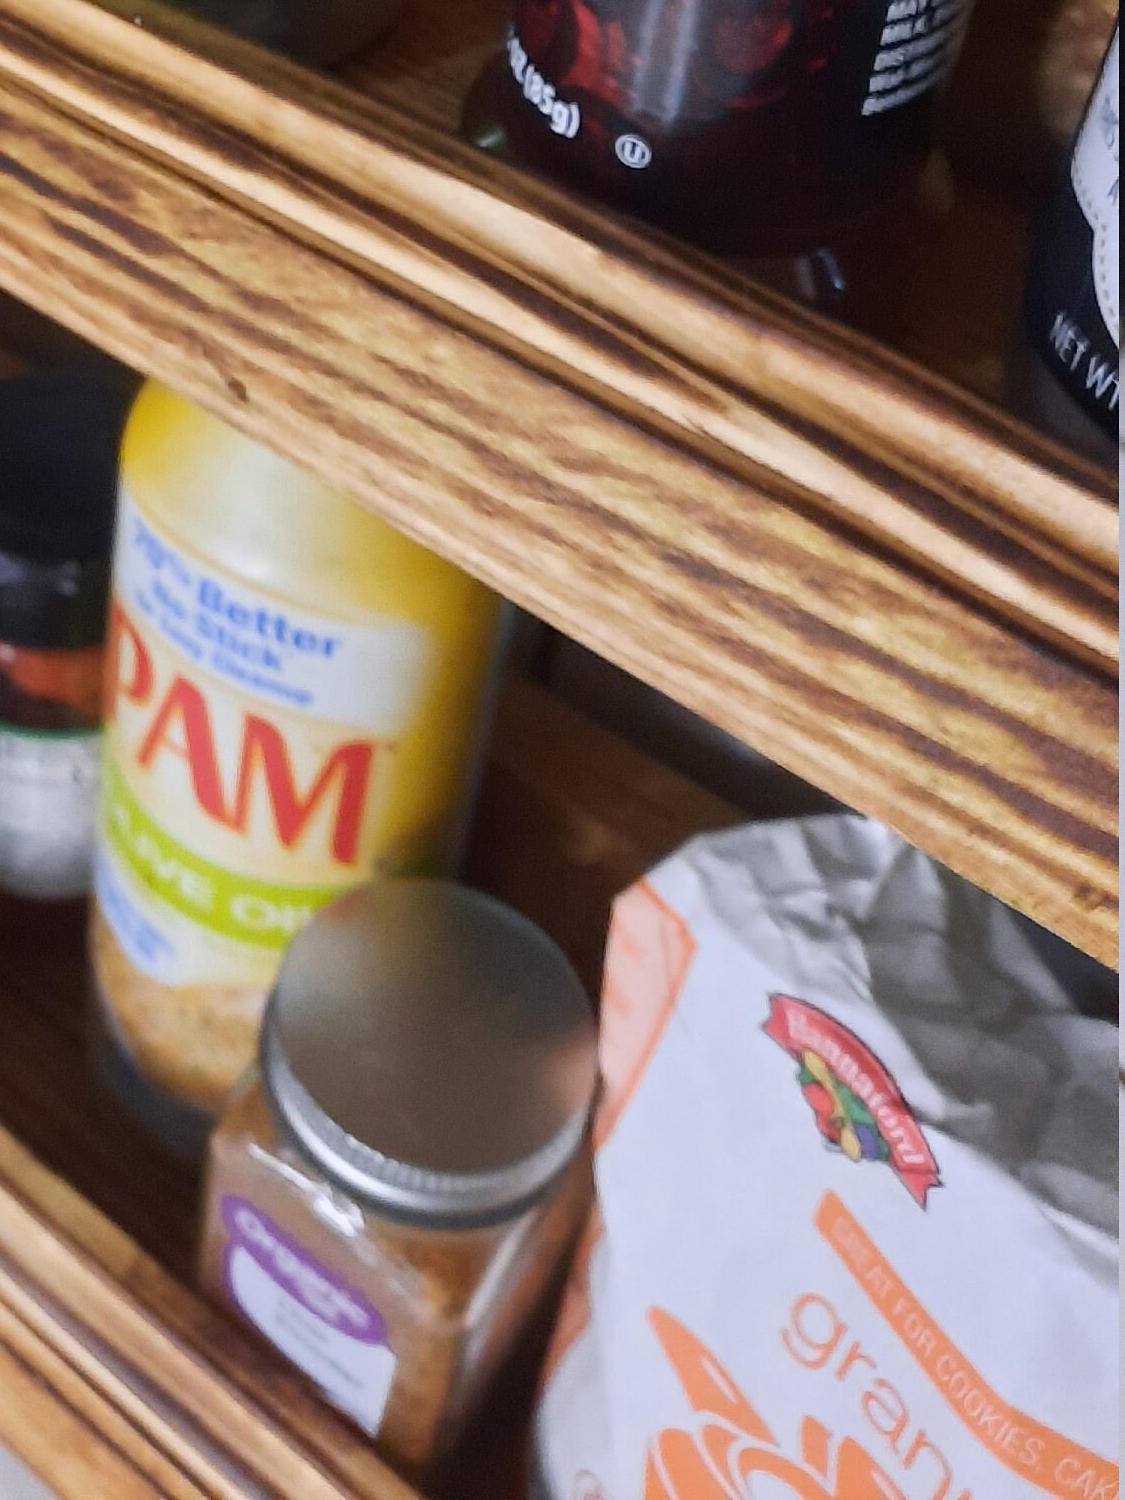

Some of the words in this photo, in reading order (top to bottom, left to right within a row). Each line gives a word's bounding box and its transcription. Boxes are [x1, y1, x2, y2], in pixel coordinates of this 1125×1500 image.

[523, 63, 581, 139] (85g)
[198, 576, 343, 659] Better
[105, 597, 379, 867] PAM
[892, 1300, 936, 1357] FOR
